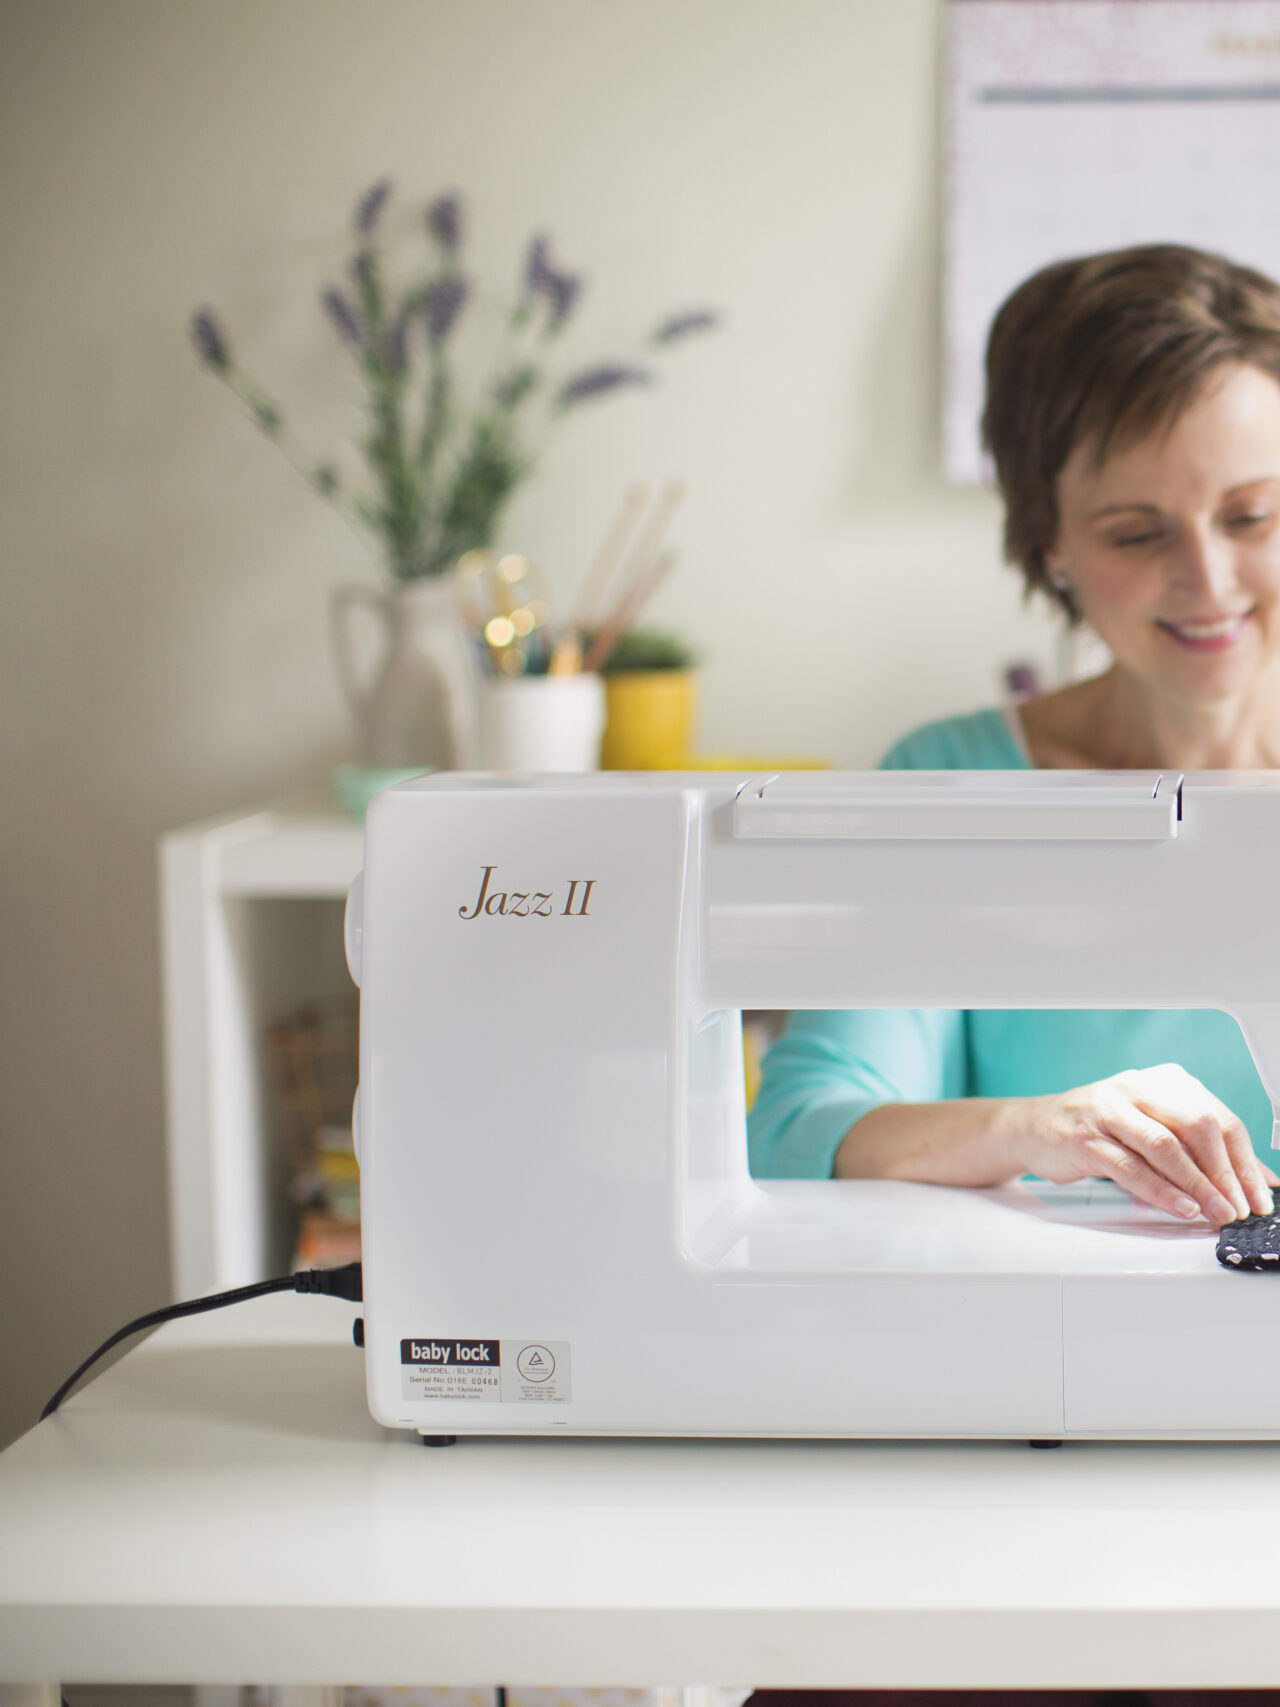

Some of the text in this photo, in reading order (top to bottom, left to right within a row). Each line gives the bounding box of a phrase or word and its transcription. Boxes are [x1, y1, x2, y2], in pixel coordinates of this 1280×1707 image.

[458, 865, 598, 920] Jazz II
[411, 1342, 490, 1364] baby lock
[419, 1367, 450, 1375] MODEL
